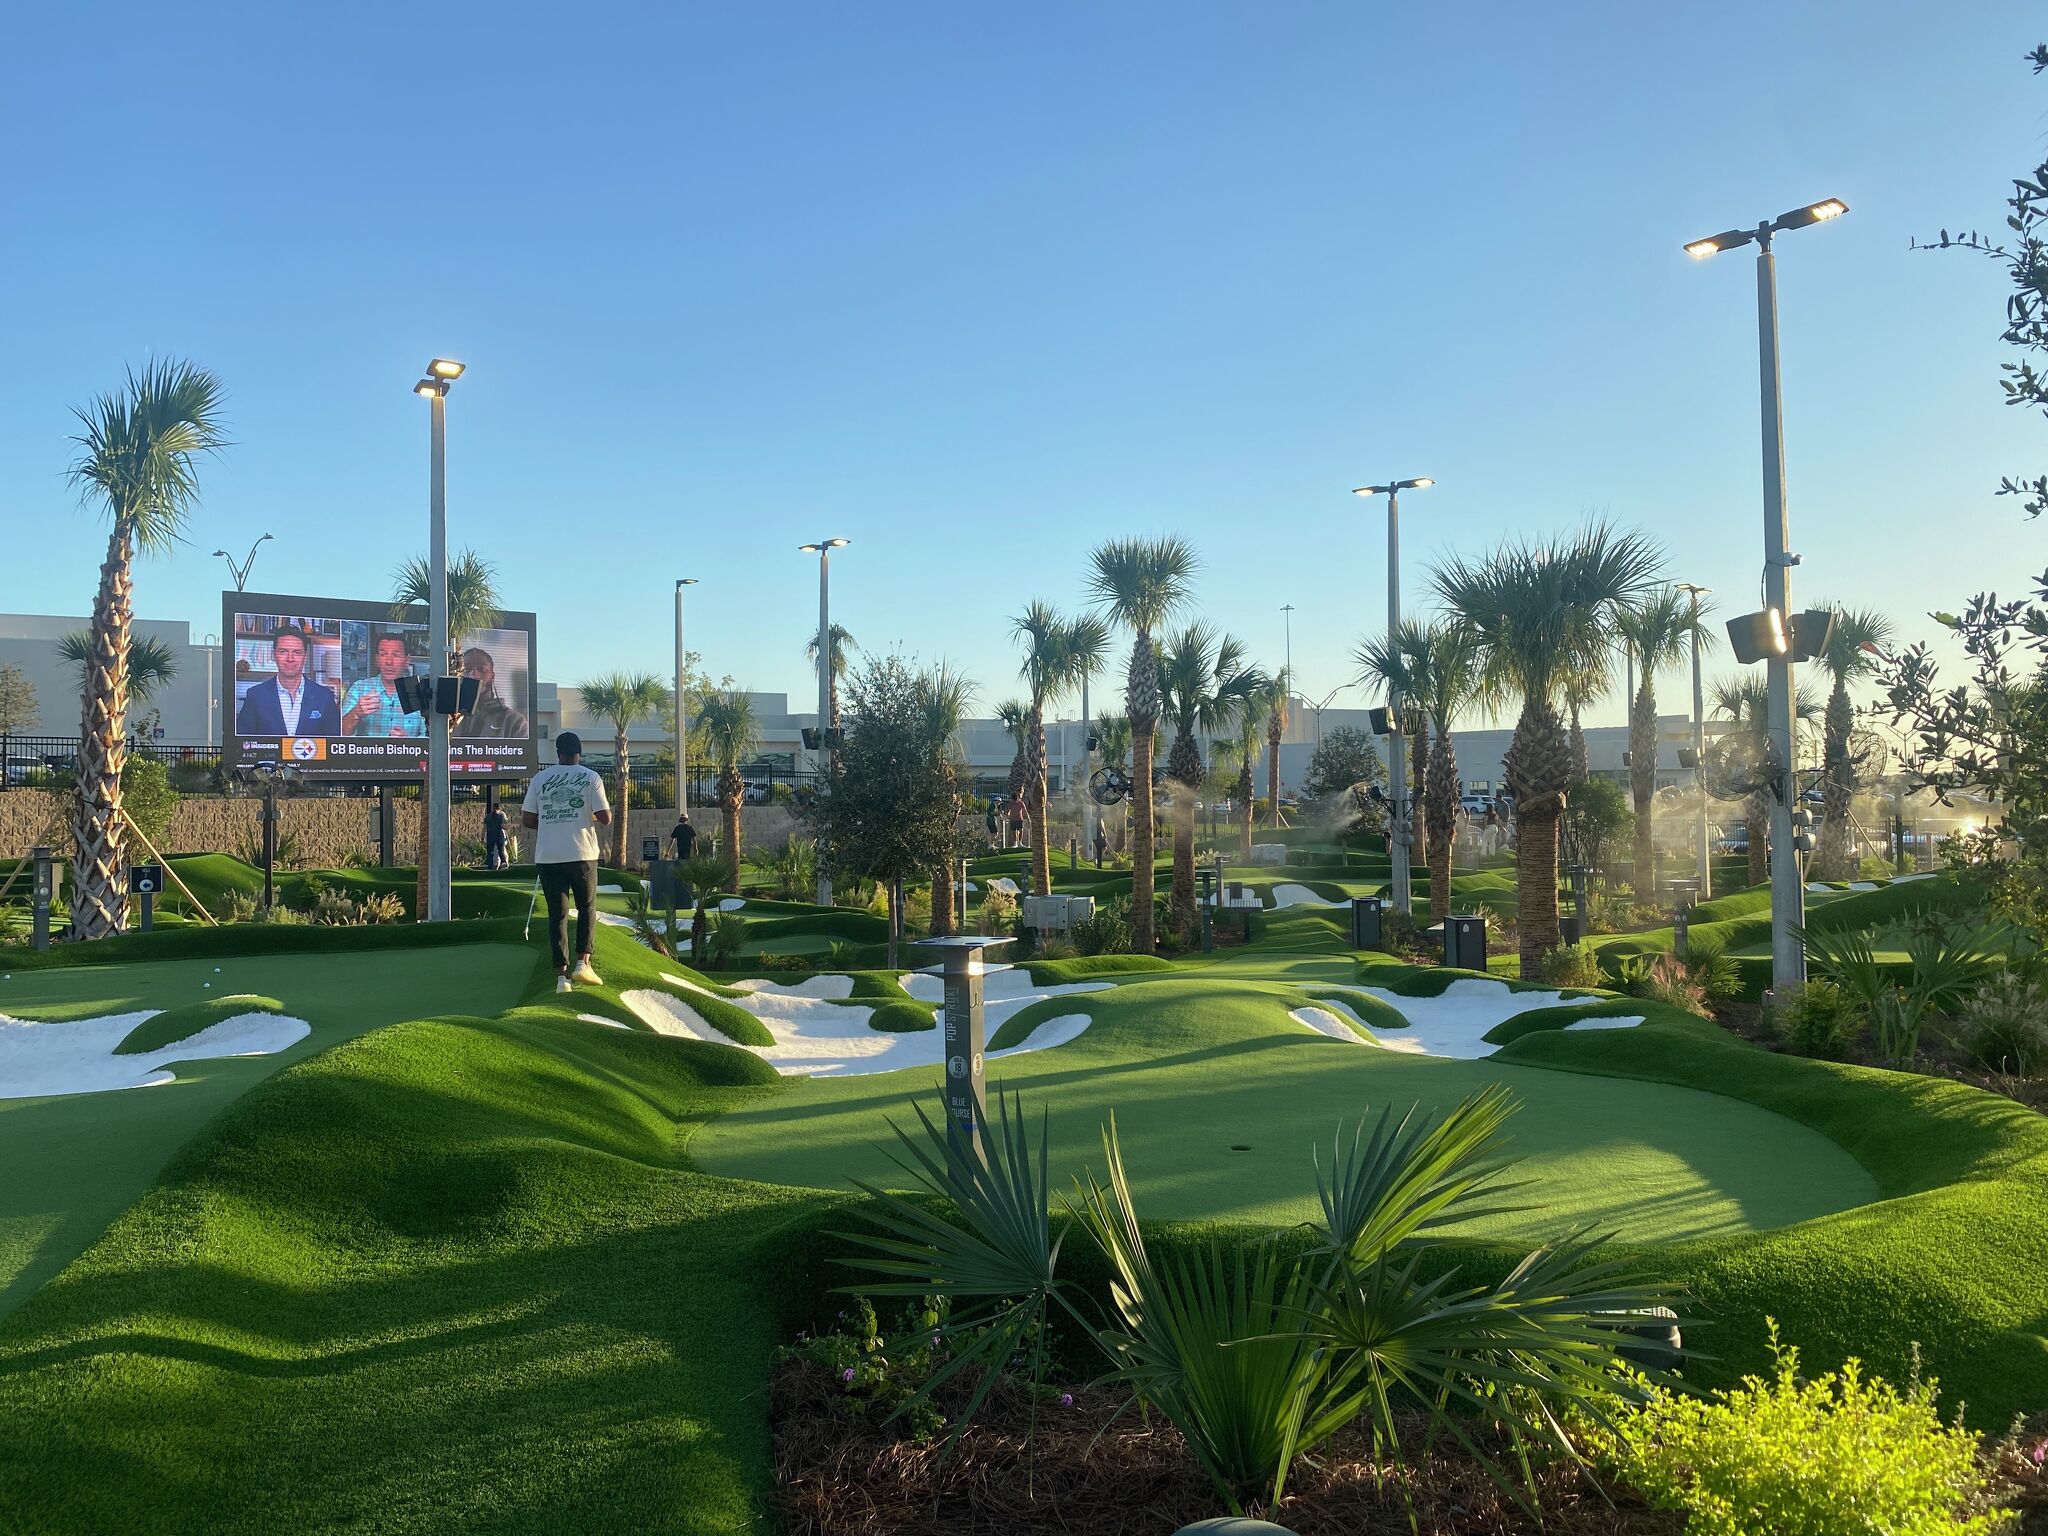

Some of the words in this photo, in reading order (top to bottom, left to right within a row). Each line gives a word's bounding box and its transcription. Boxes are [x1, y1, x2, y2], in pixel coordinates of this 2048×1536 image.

[330, 744, 346, 755] CB
[348, 744, 384, 755] Beanie
[386, 744, 421, 757] Bishop
[424, 745, 463, 756] ins
[465, 745, 484, 756] The
[485, 745, 523, 756] Insiders
[952, 1096, 966, 1106] BLUE
[950, 1108, 971, 1118] URSE
